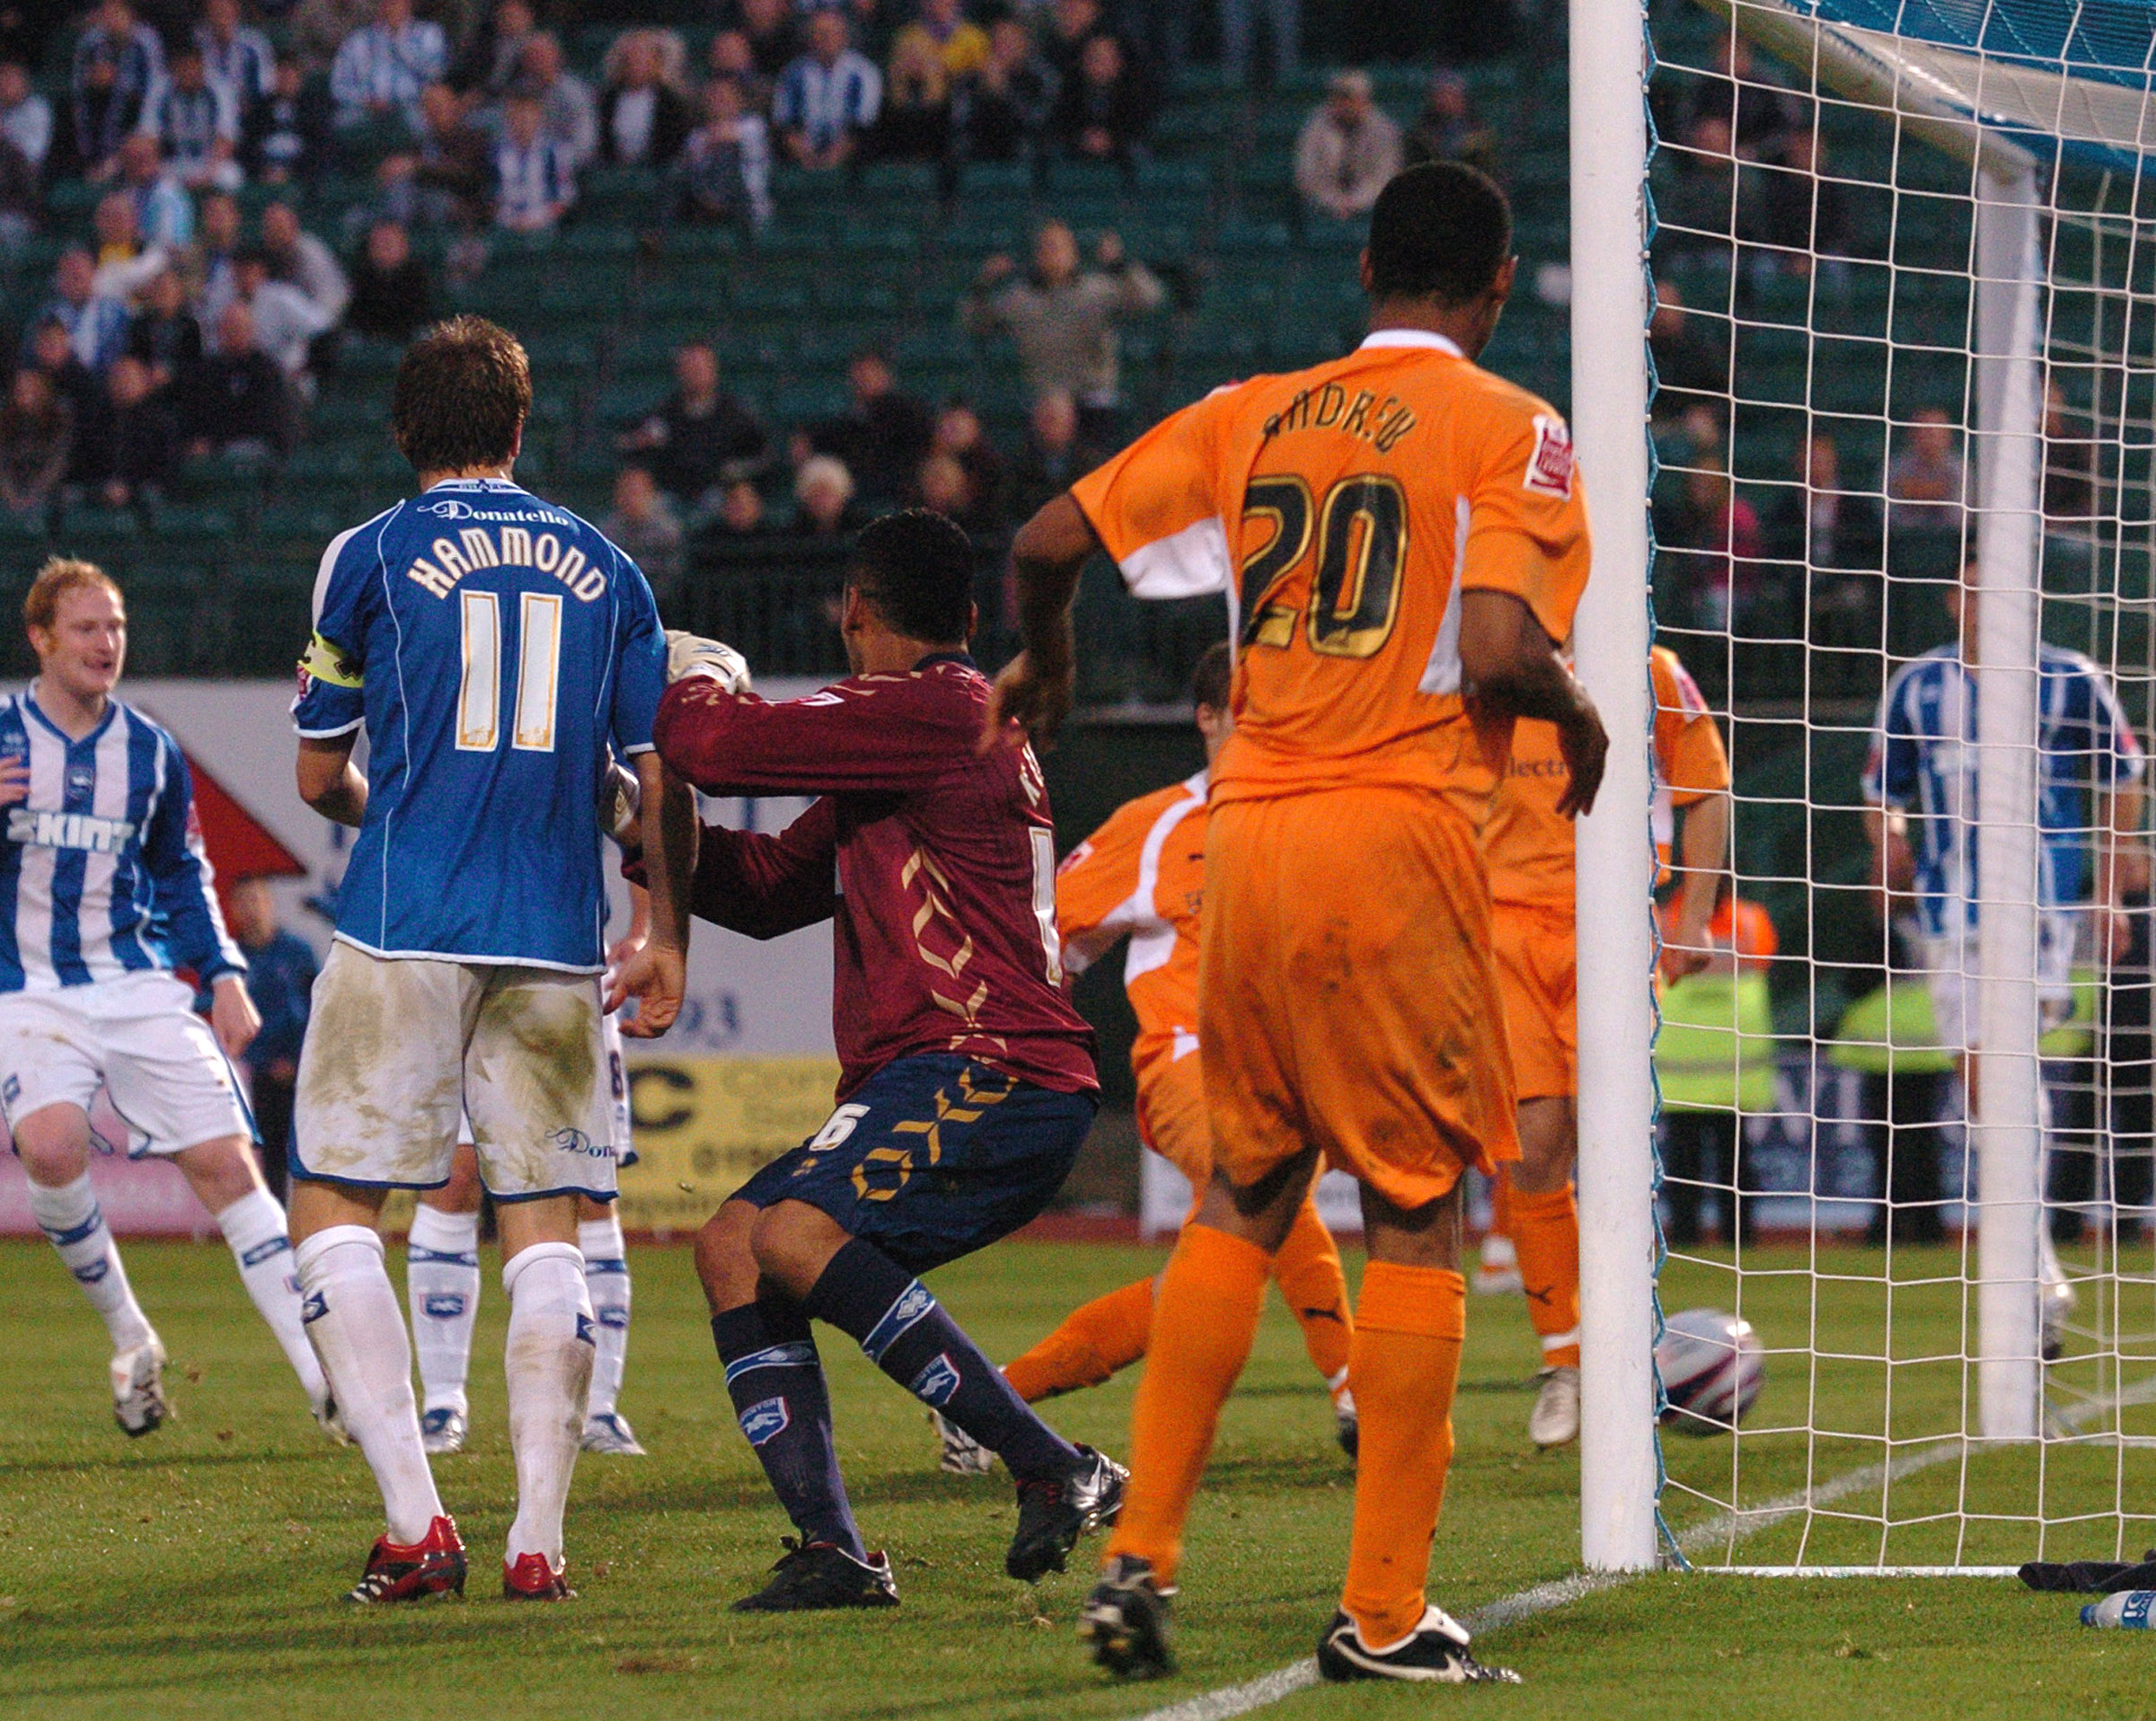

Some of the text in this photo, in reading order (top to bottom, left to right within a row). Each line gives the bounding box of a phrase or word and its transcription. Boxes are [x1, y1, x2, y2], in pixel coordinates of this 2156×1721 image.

[405, 526, 608, 604] HAMMOND
[416, 499, 570, 528] Donatello
[1239, 472, 1410, 660] 20
[455, 588, 563, 753] 11
